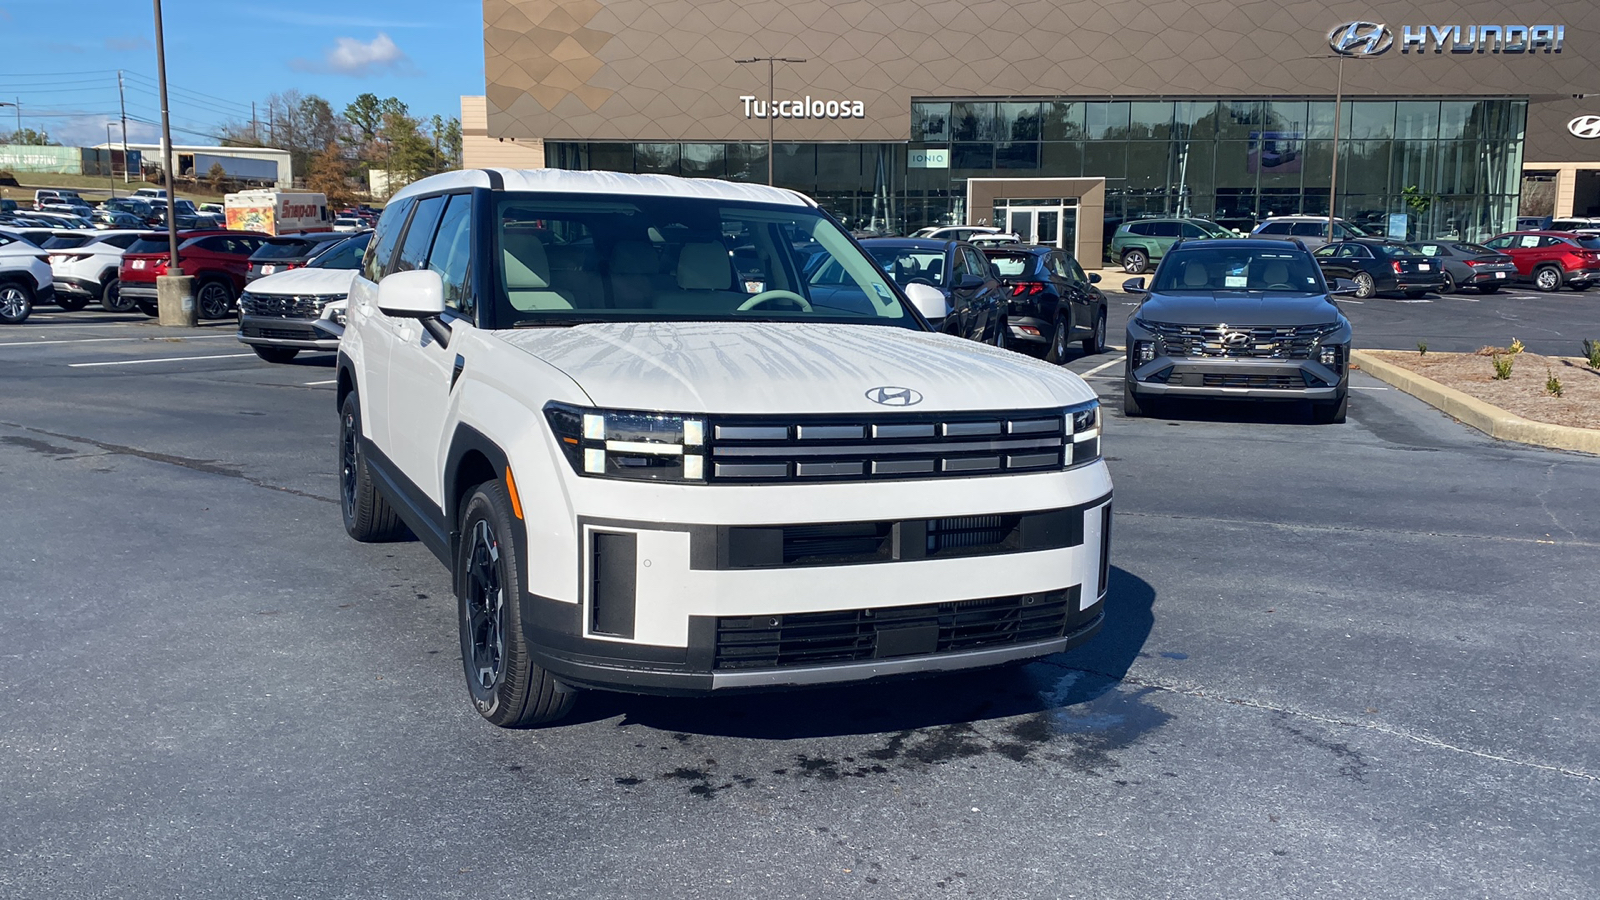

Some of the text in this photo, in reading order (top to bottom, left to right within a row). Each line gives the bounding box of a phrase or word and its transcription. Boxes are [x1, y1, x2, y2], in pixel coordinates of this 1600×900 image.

[1402, 25, 1565, 53] HYUNDAI
[739, 95, 865, 119] Tuscaloosa
[281, 199, 317, 222] Snap-on
